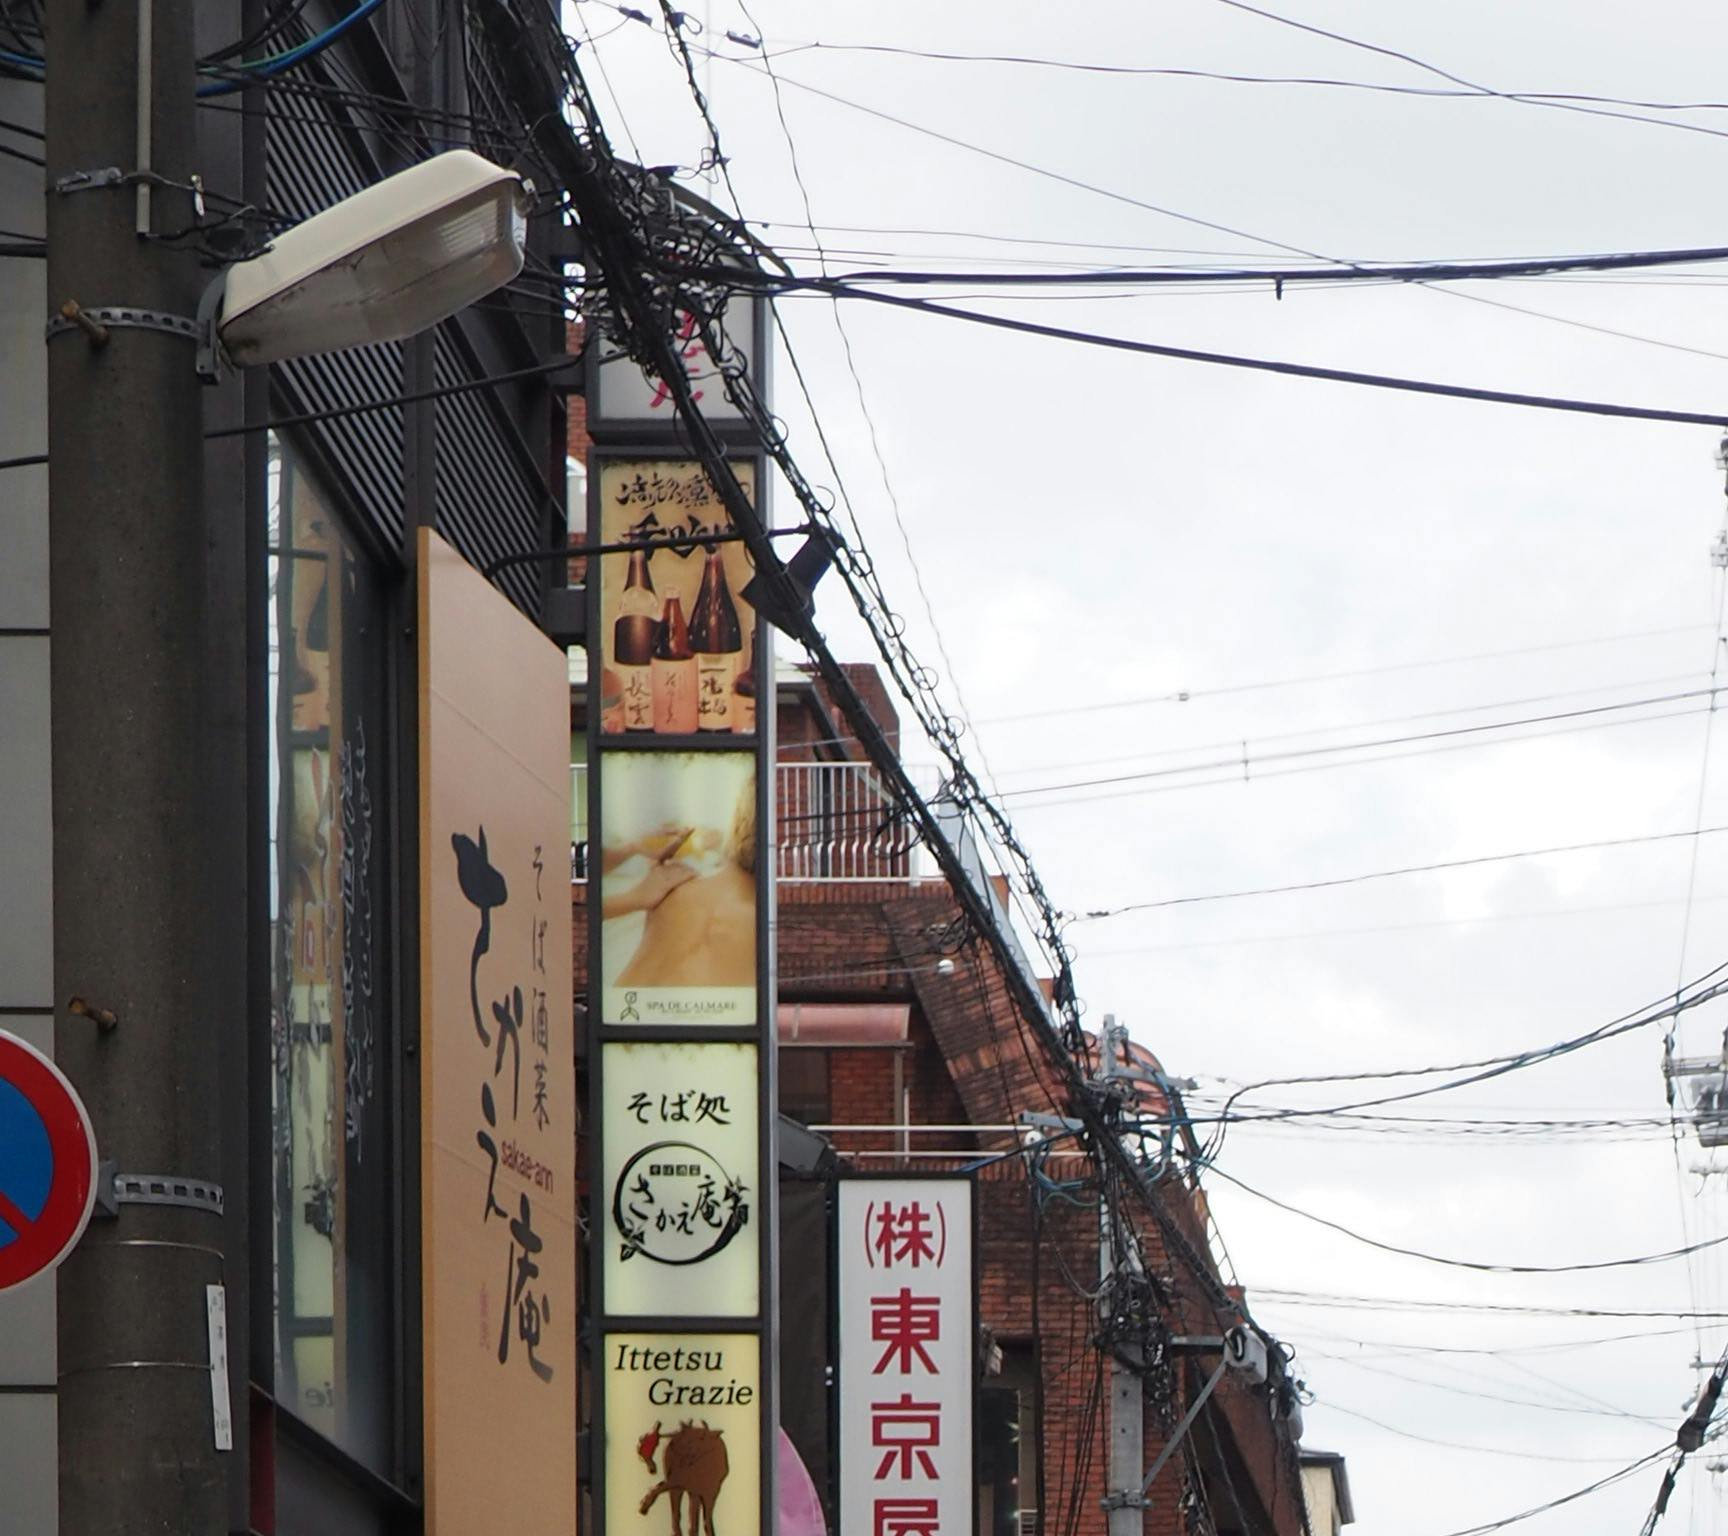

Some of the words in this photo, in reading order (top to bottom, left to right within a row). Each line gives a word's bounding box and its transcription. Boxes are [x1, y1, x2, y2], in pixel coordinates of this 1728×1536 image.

[627, 1089, 732, 1125] そば処
[614, 1344, 724, 1372] Ittetsu
[648, 1378, 754, 1406] Grazie
